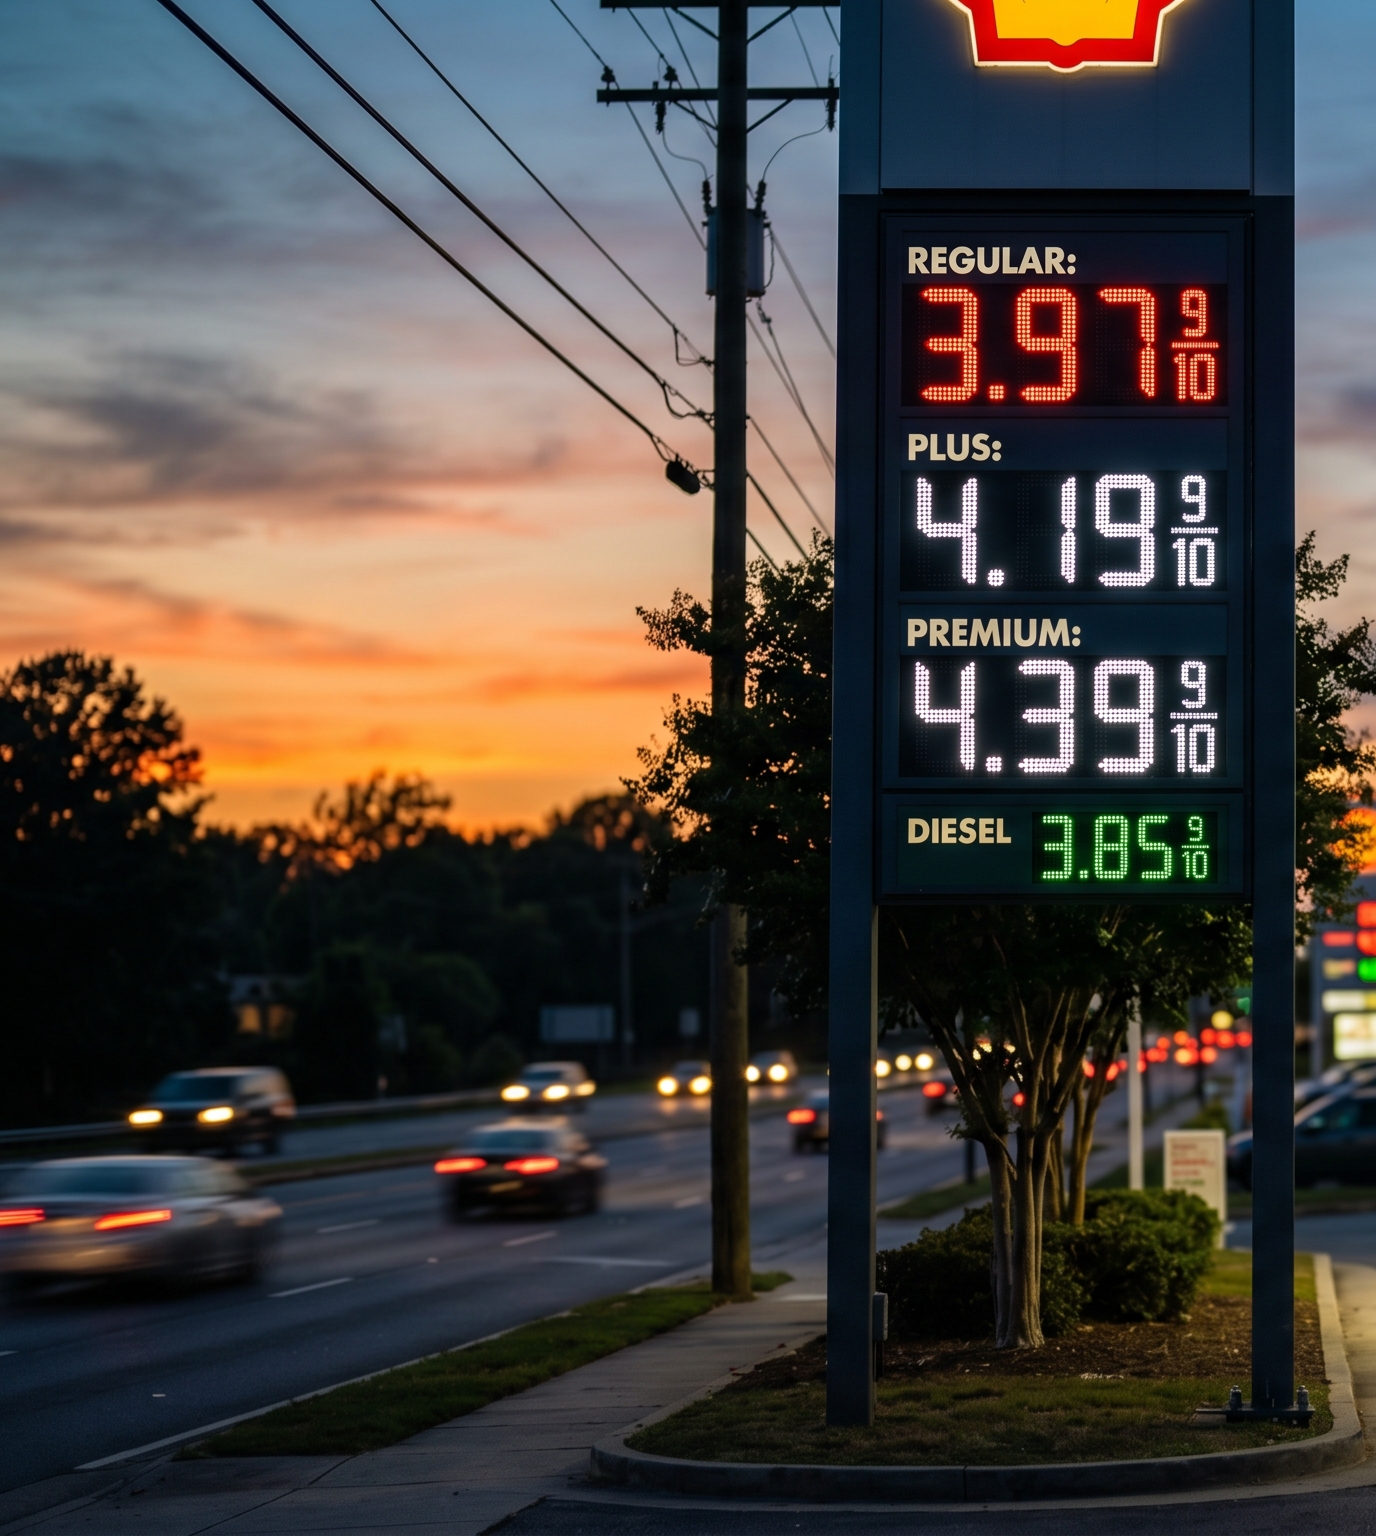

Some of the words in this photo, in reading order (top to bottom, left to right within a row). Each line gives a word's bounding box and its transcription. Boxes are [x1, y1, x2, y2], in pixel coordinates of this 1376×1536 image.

[909, 247, 1076, 274] REGULAR:
[1182, 289, 1207, 337] 9
[922, 288, 1155, 401] 3.97
[1174, 352, 1215, 400] 10
[909, 434, 1001, 461] PLUS:
[1181, 475, 1206, 523] 9
[917, 474, 1155, 586] 4.19
[1172, 538, 1215, 586] 10
[908, 619, 1080, 646] PREMIUM:
[1181, 661, 1206, 708] 9
[915, 660, 1154, 773] 4.39
[1171, 724, 1215, 772] 10
[909, 818, 1011, 843] DIESEL
[1043, 816, 1172, 879] 3.85
[1188, 816, 1202, 841] 9
[1182, 851, 1207, 878] 10
